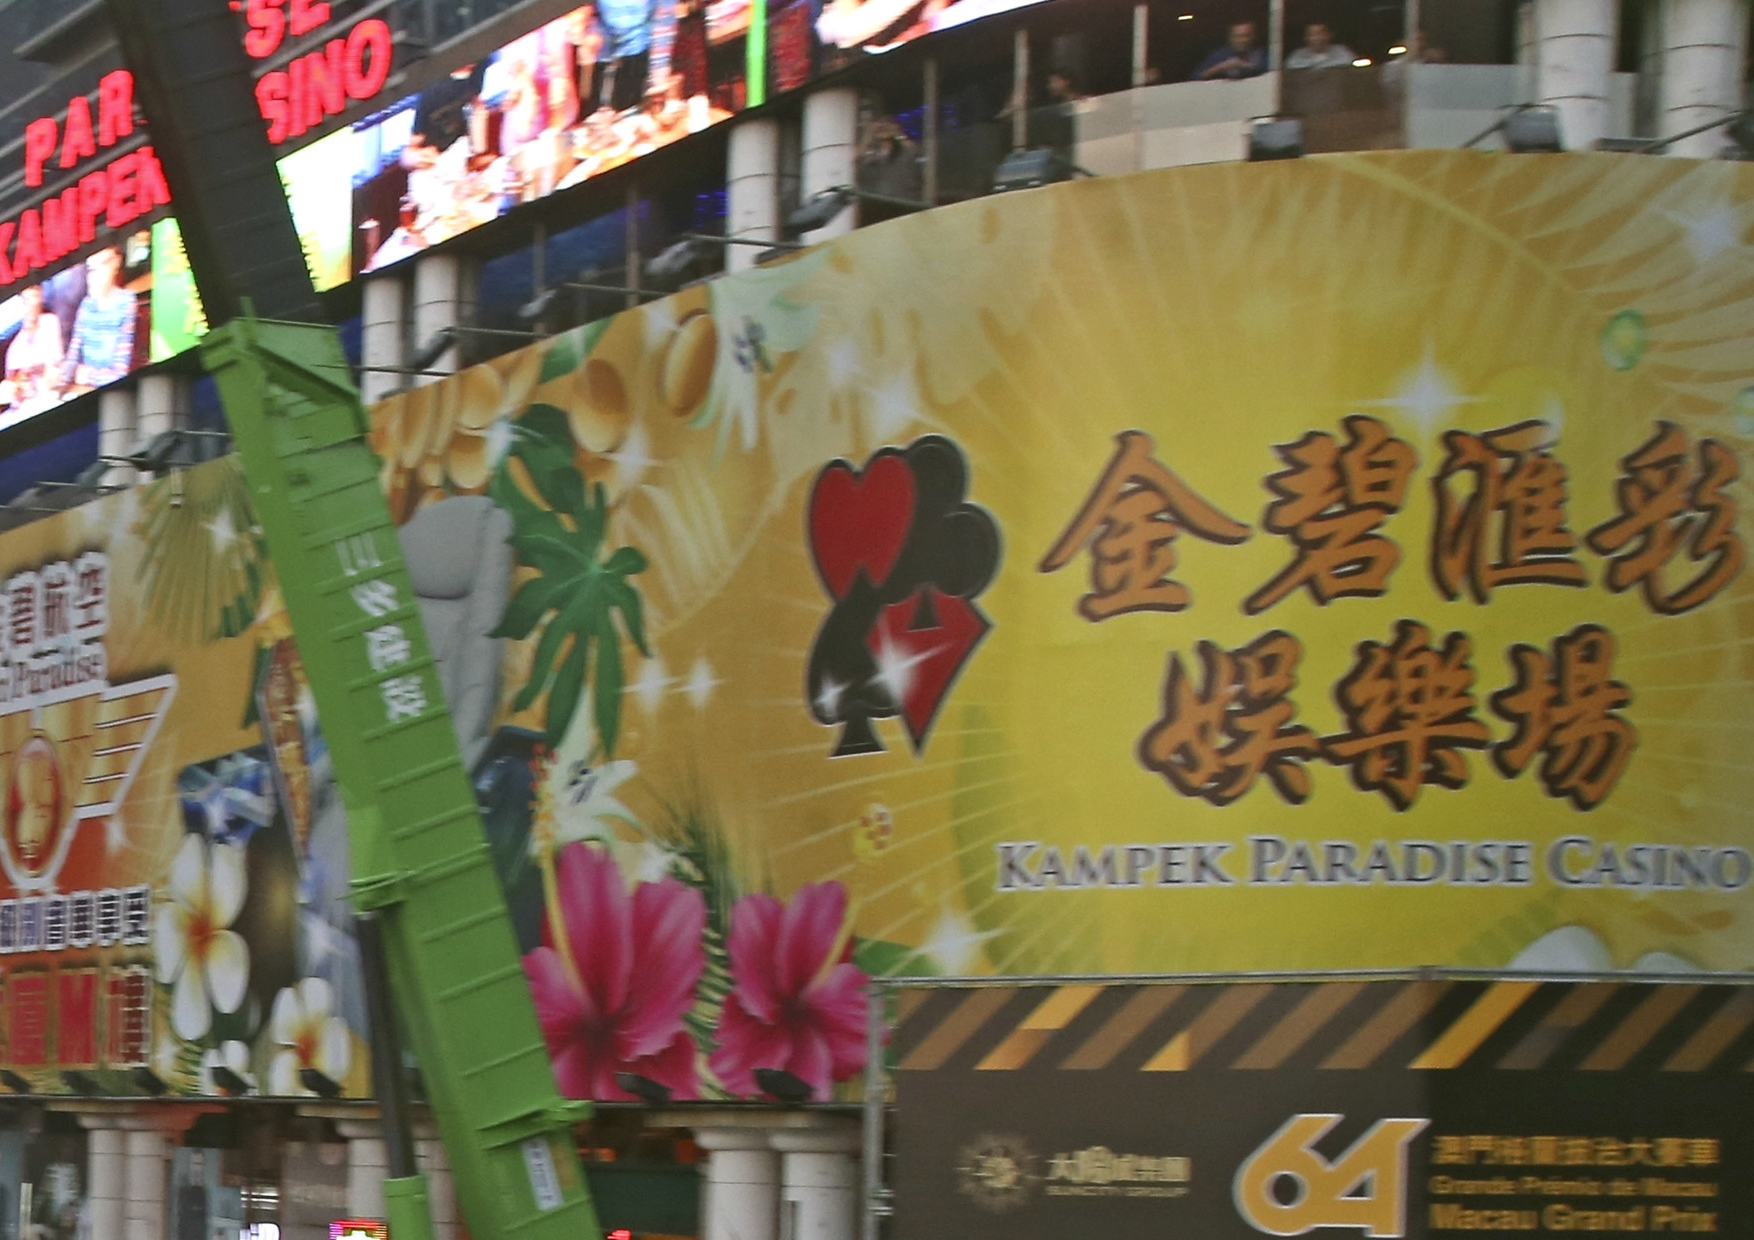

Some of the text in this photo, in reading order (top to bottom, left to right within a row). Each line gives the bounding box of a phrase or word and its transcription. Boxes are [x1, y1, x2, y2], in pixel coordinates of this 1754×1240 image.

[254, 19, 392, 144] SINO
[996, 836, 1754, 892] KAMPEK PARADISE CASINO
[1232, 1113, 1432, 1238] 64
[1430, 1203, 1719, 1232] Macau Grand Prix
